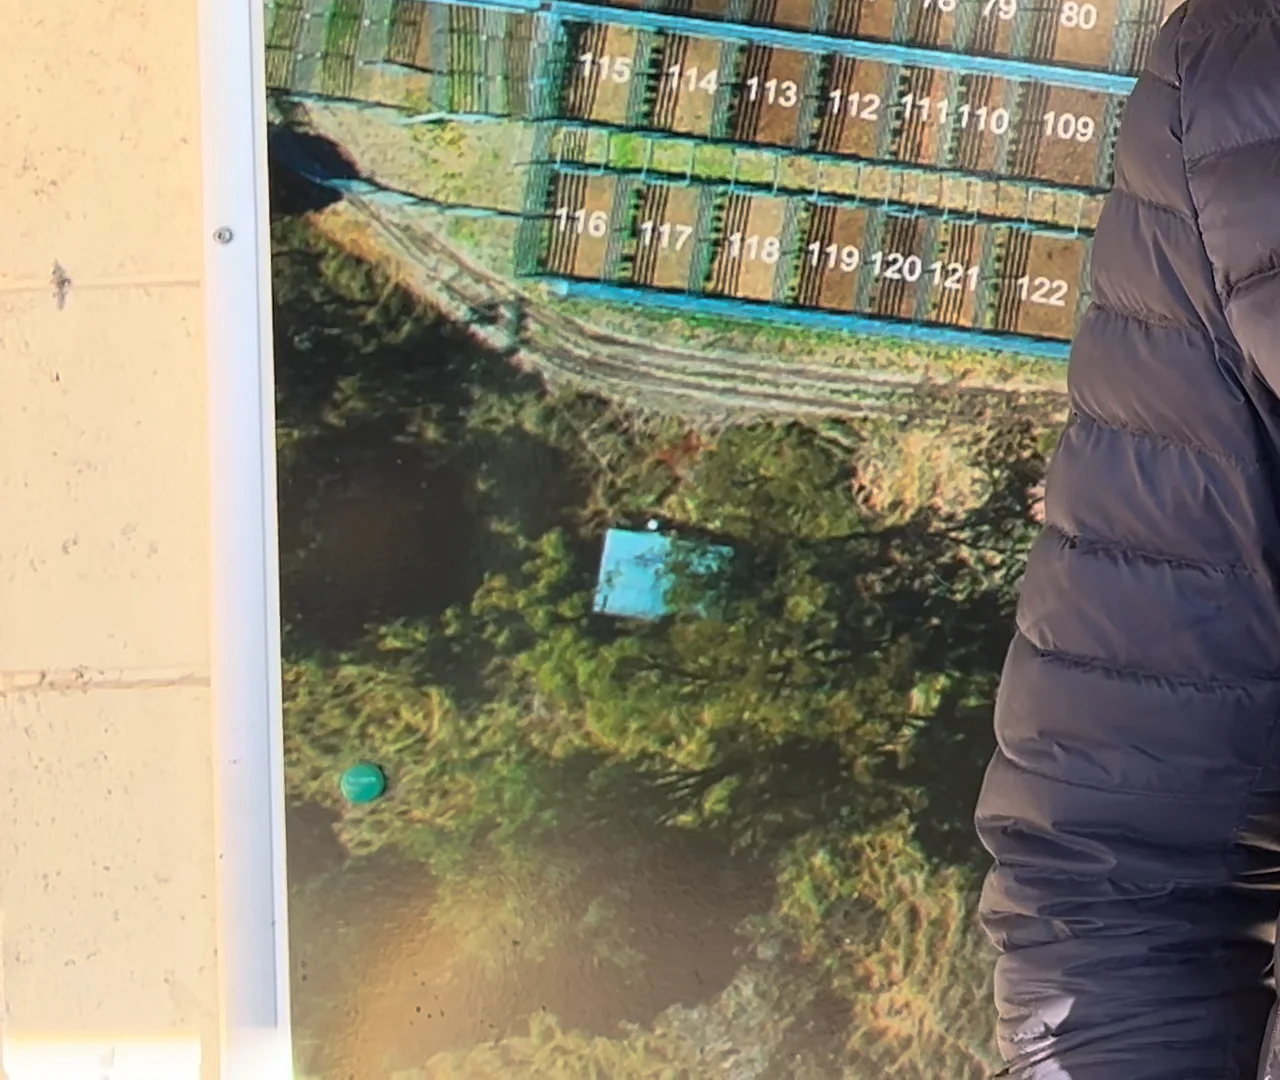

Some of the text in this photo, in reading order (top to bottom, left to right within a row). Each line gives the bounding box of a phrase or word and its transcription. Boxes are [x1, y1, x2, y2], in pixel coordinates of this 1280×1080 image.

[1061, 2, 1097, 31] 80
[578, 52, 631, 85] 115
[667, 63, 719, 96] 114
[745, 76, 799, 109] 113
[827, 88, 881, 121] 112
[900, 94, 949, 124] 111
[958, 104, 1009, 135] 110
[1042, 111, 1095, 143] 109
[555, 206, 608, 238] 116
[639, 220, 693, 252] 117
[727, 232, 780, 264] 118
[807, 241, 860, 273] 119
[870, 251, 921, 283] 120
[930, 262, 979, 291] 121
[1017, 276, 1069, 308] 122
